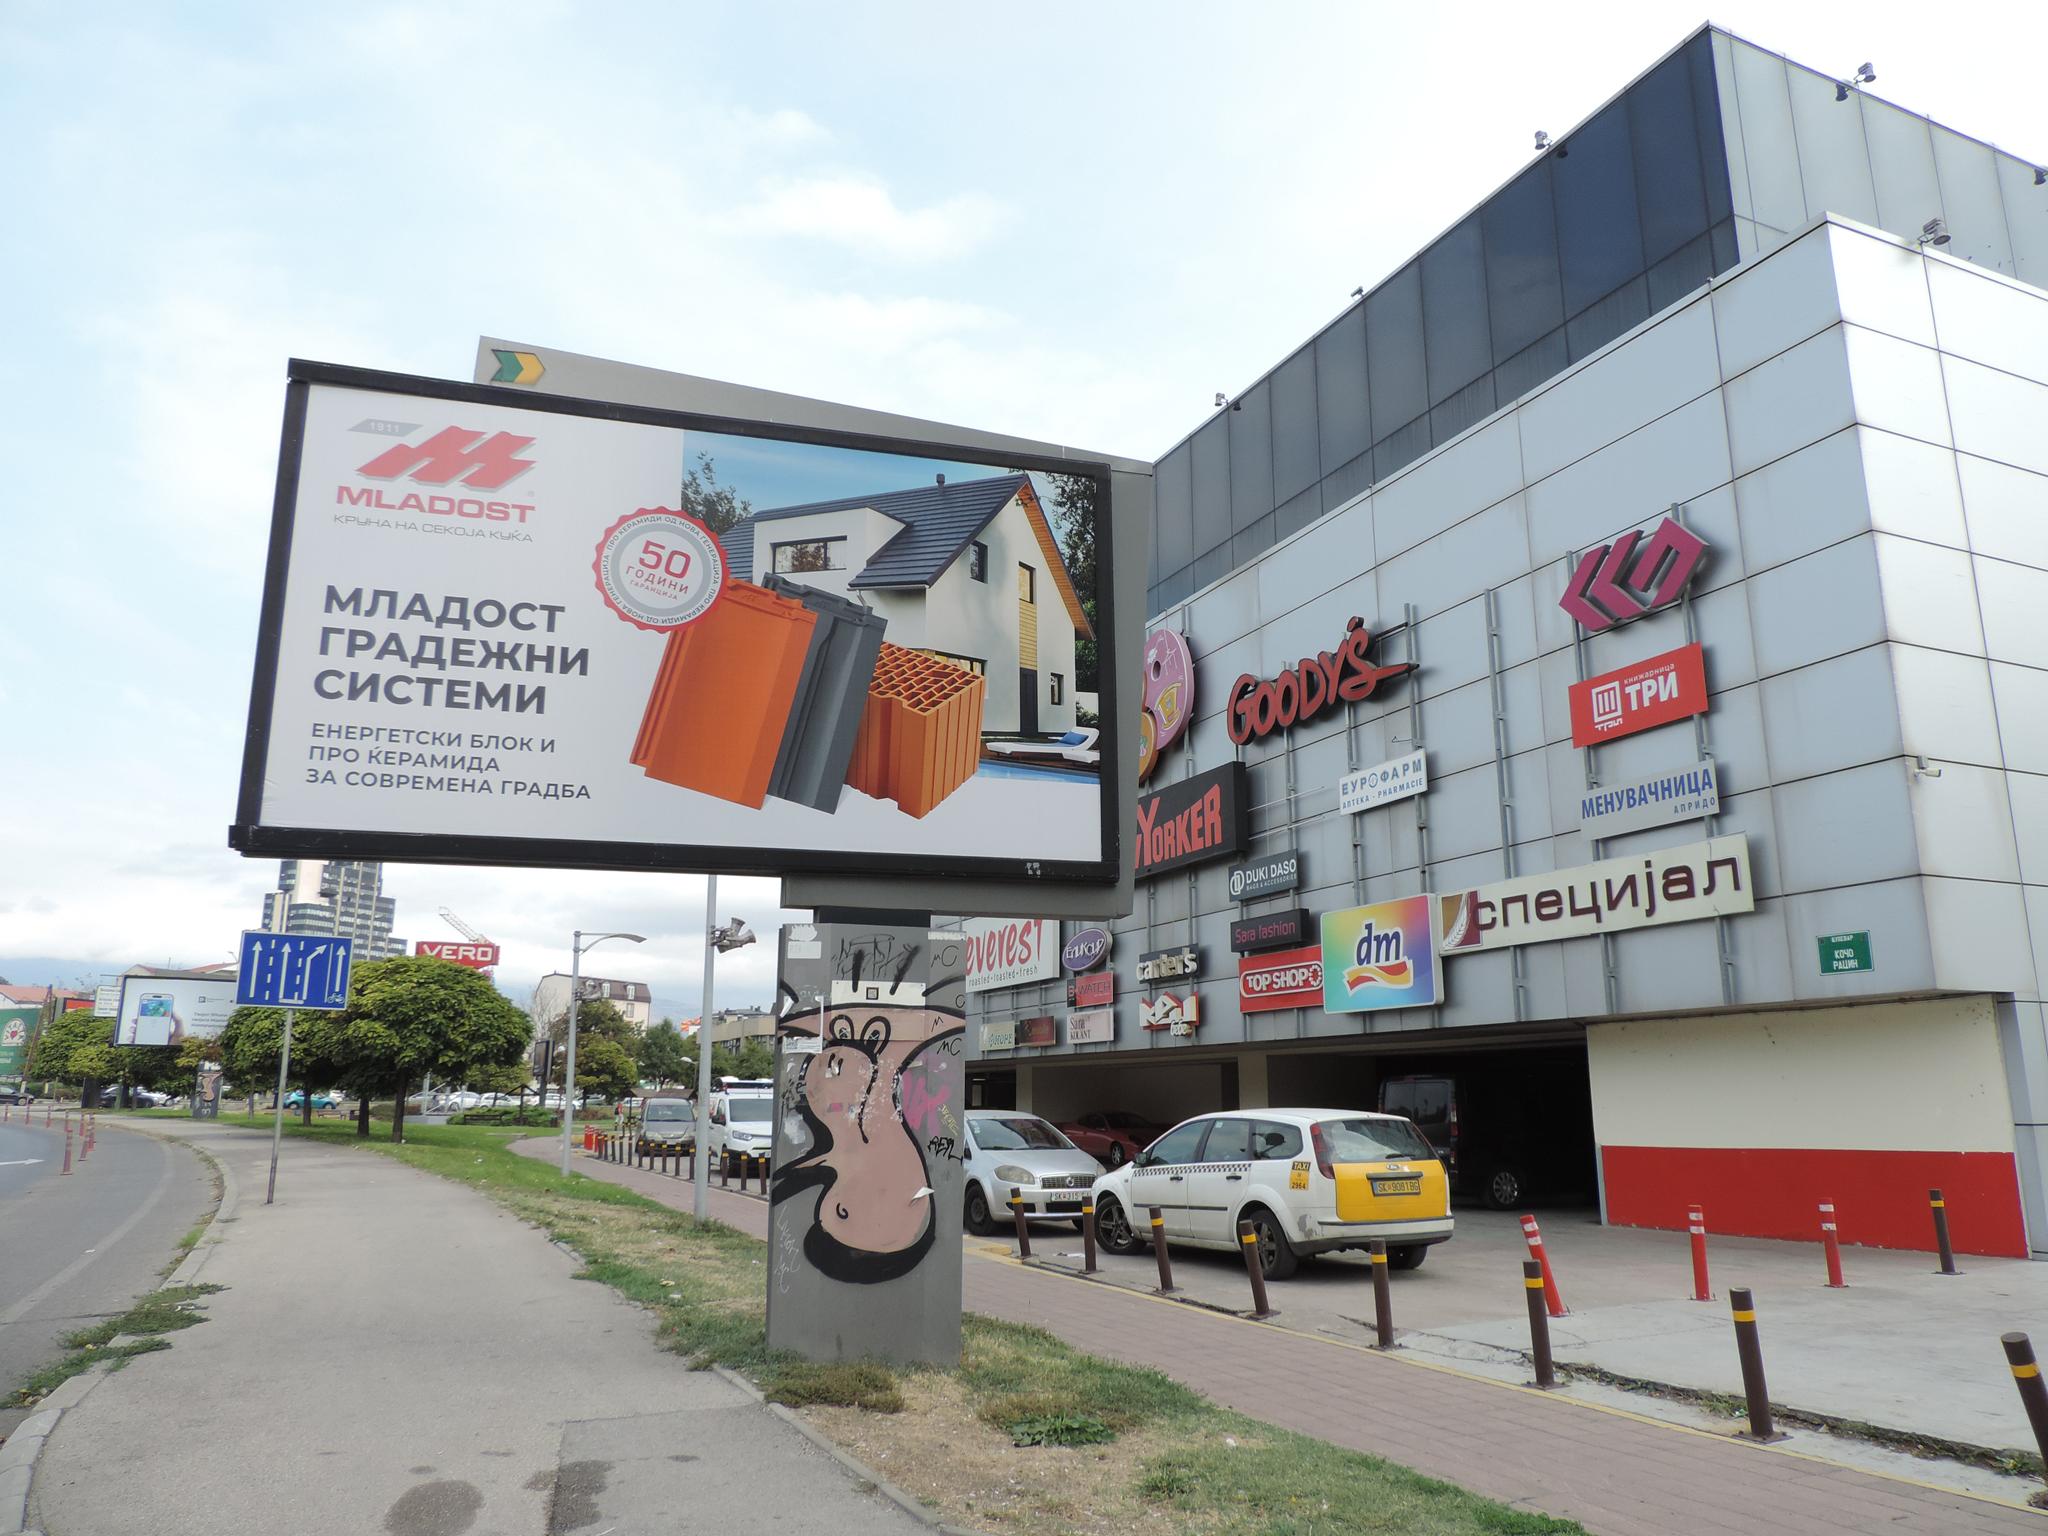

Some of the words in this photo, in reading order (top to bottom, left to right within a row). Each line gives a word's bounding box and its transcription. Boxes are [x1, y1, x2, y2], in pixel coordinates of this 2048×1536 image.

[368, 421, 400, 433] 1911
[336, 485, 536, 523] MLADOST
[334, 514, 392, 528] КРУНА
[395, 521, 418, 532] НА
[422, 523, 486, 538] СЕКОЈА
[639, 540, 692, 579] 50
[626, 566, 689, 595] ГОДИНИ
[324, 585, 566, 633] МЛАДОСТ
[319, 627, 590, 677] ГРАДЕЖНИ
[314, 669, 547, 715] СИСТЕМИ
[1625, 671, 1679, 711] ТРИ
[311, 723, 463, 748] ЕНЕРГЕТСКИ
[470, 734, 533, 753] БЛОК
[541, 739, 555, 753] И
[309, 745, 360, 763] ПРО
[368, 747, 500, 774] ЌЕРАМИДА
[306, 768, 337, 785] ЗА
[345, 771, 493, 795] СОВРЕМЕНА
[501, 780, 591, 800] ГРАДБА
[1342, 758, 1422, 795] ЕУРОФАРМ
[1343, 795, 1369, 809] АПТЕКА
[1378, 778, 1423, 798] PHARMACIE
[1582, 768, 1713, 819] МЕНУВАЧНИЦА
[1674, 797, 1716, 814] АПРИДО
[1246, 866, 1268, 884] DUKI
[1270, 859, 1297, 878] DASO
[1475, 857, 1741, 931] специјал
[966, 919, 1043, 976] everest
[1235, 928, 1256, 943] Sara
[1356, 922, 1401, 966] dm
[423, 944, 493, 961] VERO
[1136, 947, 1197, 980] carter's
[1834, 948, 1854, 959] КОЧО
[1246, 973, 1271, 991] TOP
[1272, 968, 1309, 990] SHOP
[1294, 1161, 1310, 1171] TAXI
